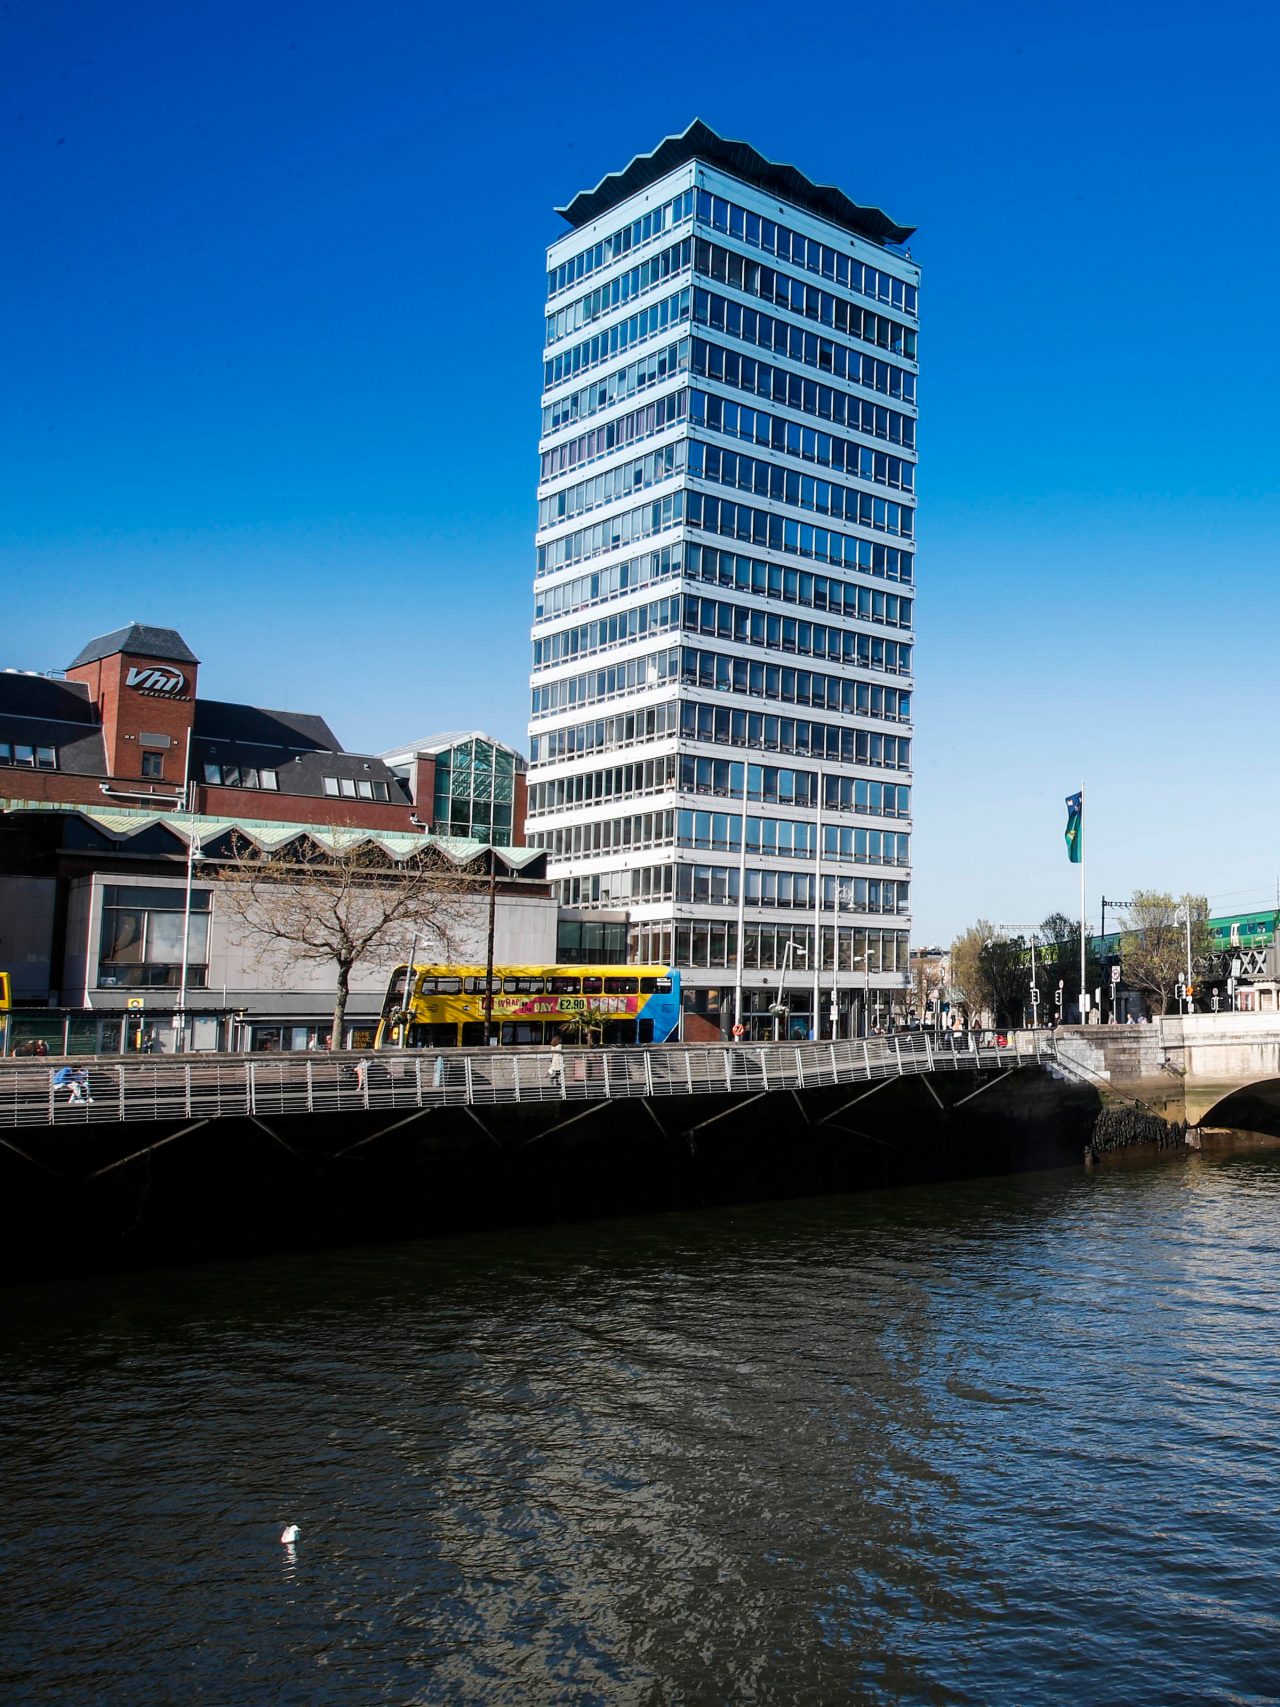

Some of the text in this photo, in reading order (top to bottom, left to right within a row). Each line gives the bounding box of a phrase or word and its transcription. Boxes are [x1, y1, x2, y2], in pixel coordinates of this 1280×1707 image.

[125, 666, 181, 691] Vhi
[138, 690, 191, 701] HEALTHCARE
[498, 998, 520, 1008] WRAP
[534, 1002, 554, 1013] DAY
[560, 1000, 585, 1010] €2.90
